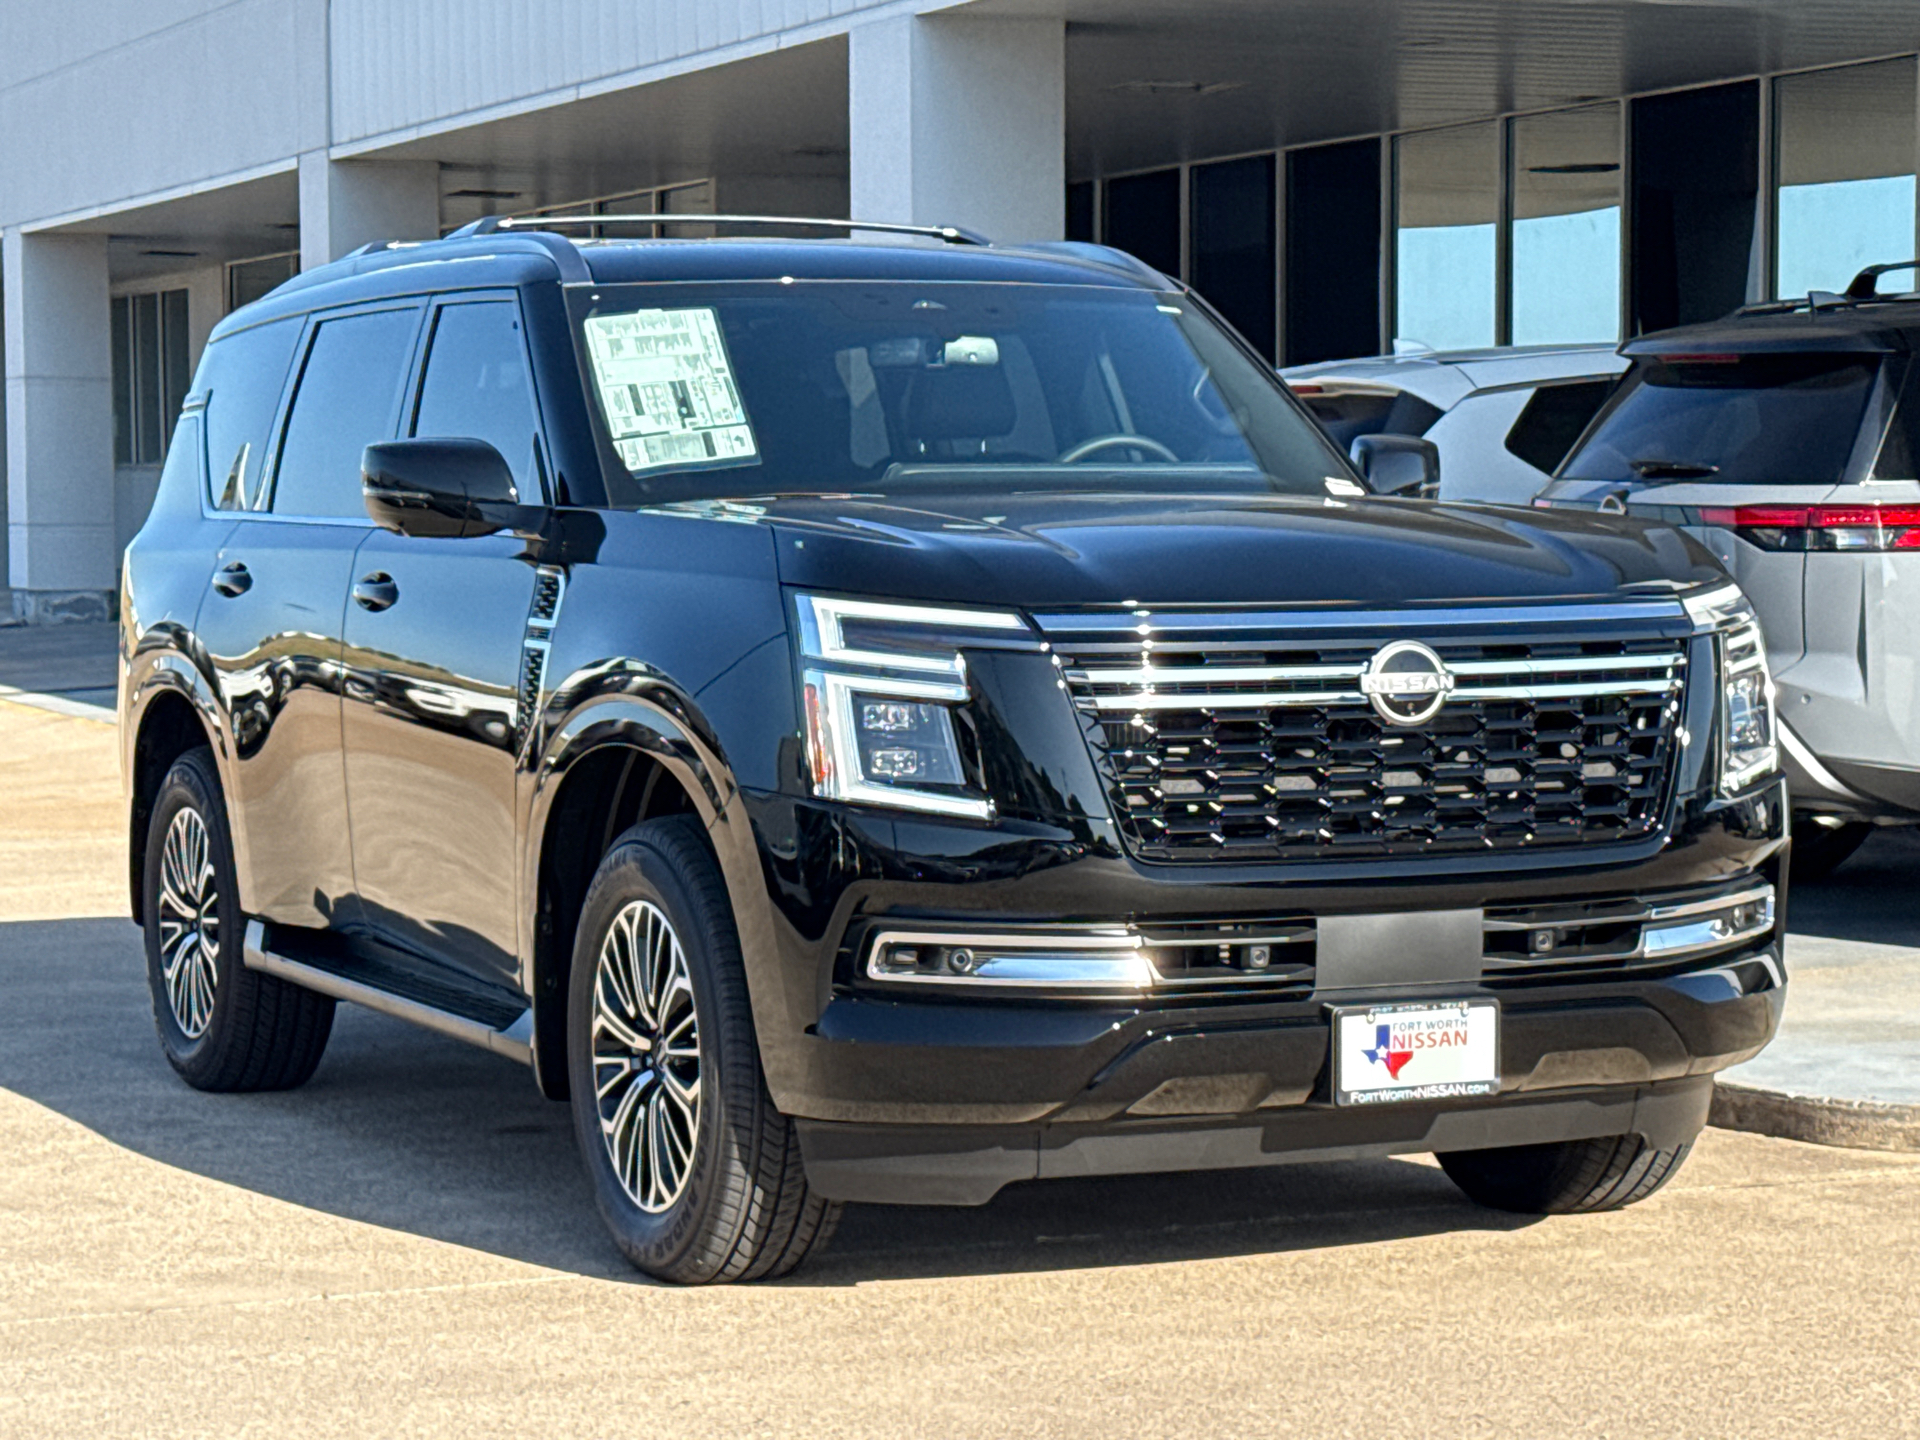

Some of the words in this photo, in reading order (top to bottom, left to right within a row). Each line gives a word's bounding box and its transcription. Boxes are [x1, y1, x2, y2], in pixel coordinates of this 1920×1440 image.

[1365, 674, 1454, 692] NISSAN
[1393, 1021, 1421, 1032] FORT
[1426, 1018, 1468, 1030] WORTH
[1392, 1030, 1468, 1050] NISSAN
